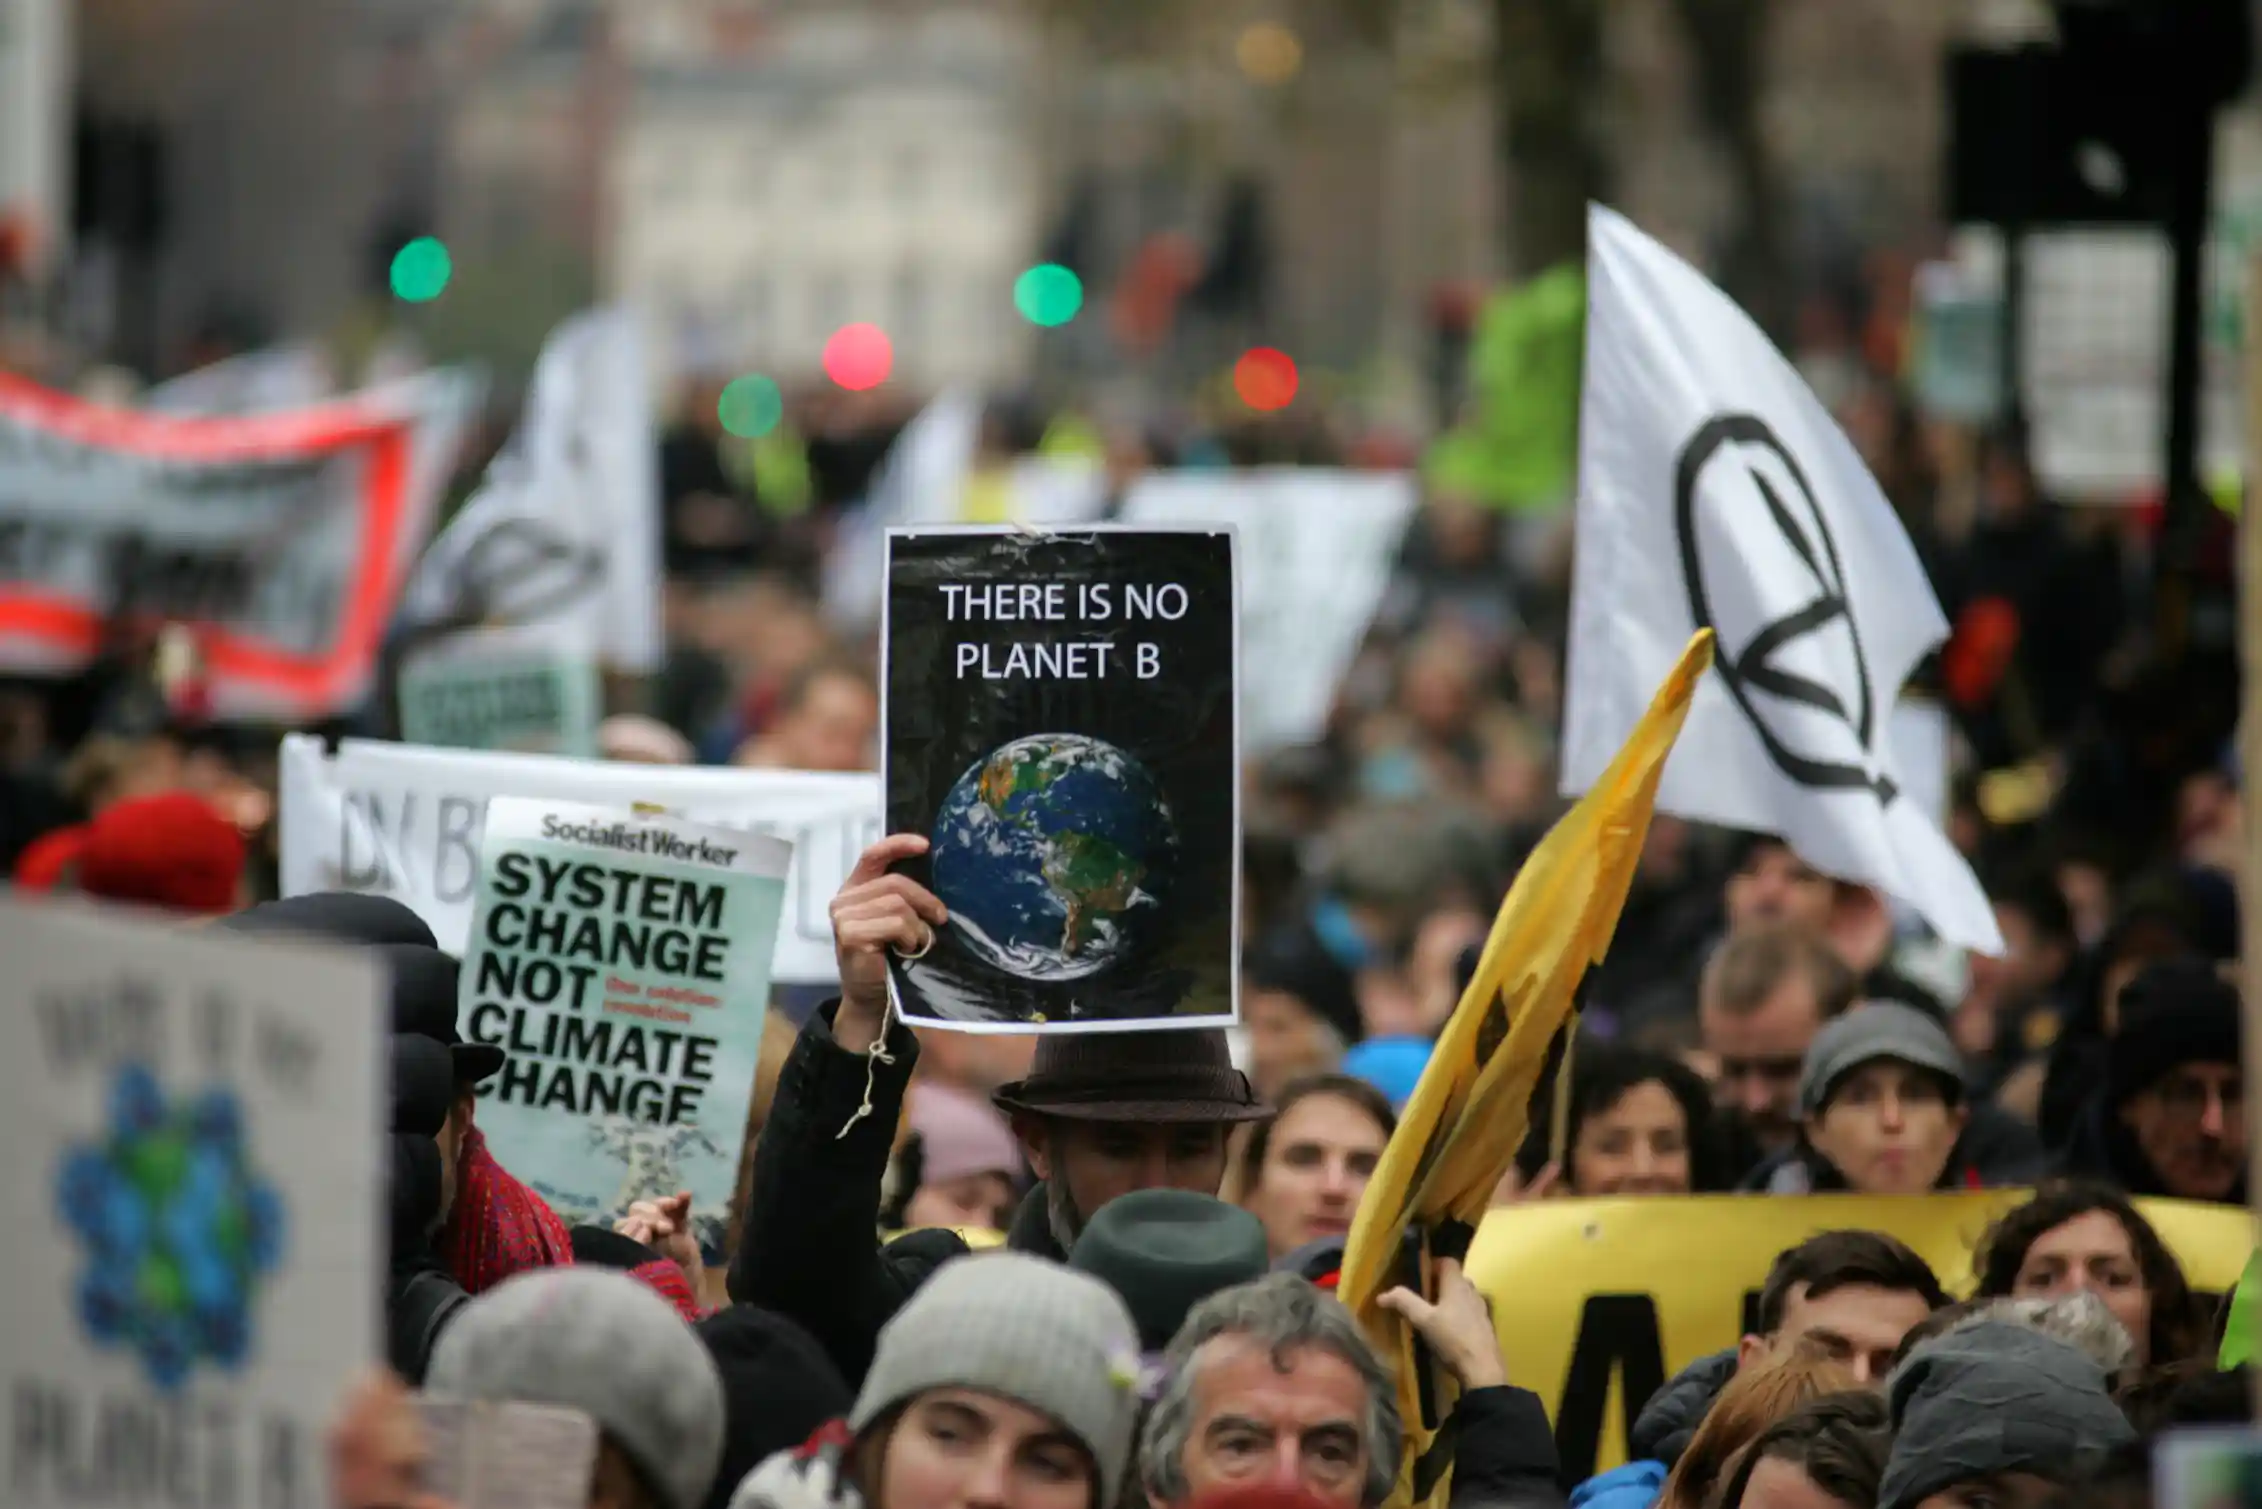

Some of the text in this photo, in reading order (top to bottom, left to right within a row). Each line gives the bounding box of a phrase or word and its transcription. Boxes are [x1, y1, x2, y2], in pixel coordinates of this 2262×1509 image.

[938, 582, 1189, 621] THERE IS NO
[956, 642, 1161, 680] PLANET B
[542, 813, 738, 867] Socialist Worker
[491, 852, 727, 930] SYSTEM
[486, 903, 729, 982] CHANGE
[475, 952, 597, 1011] NOT
[468, 1003, 719, 1083] CLIMATE
